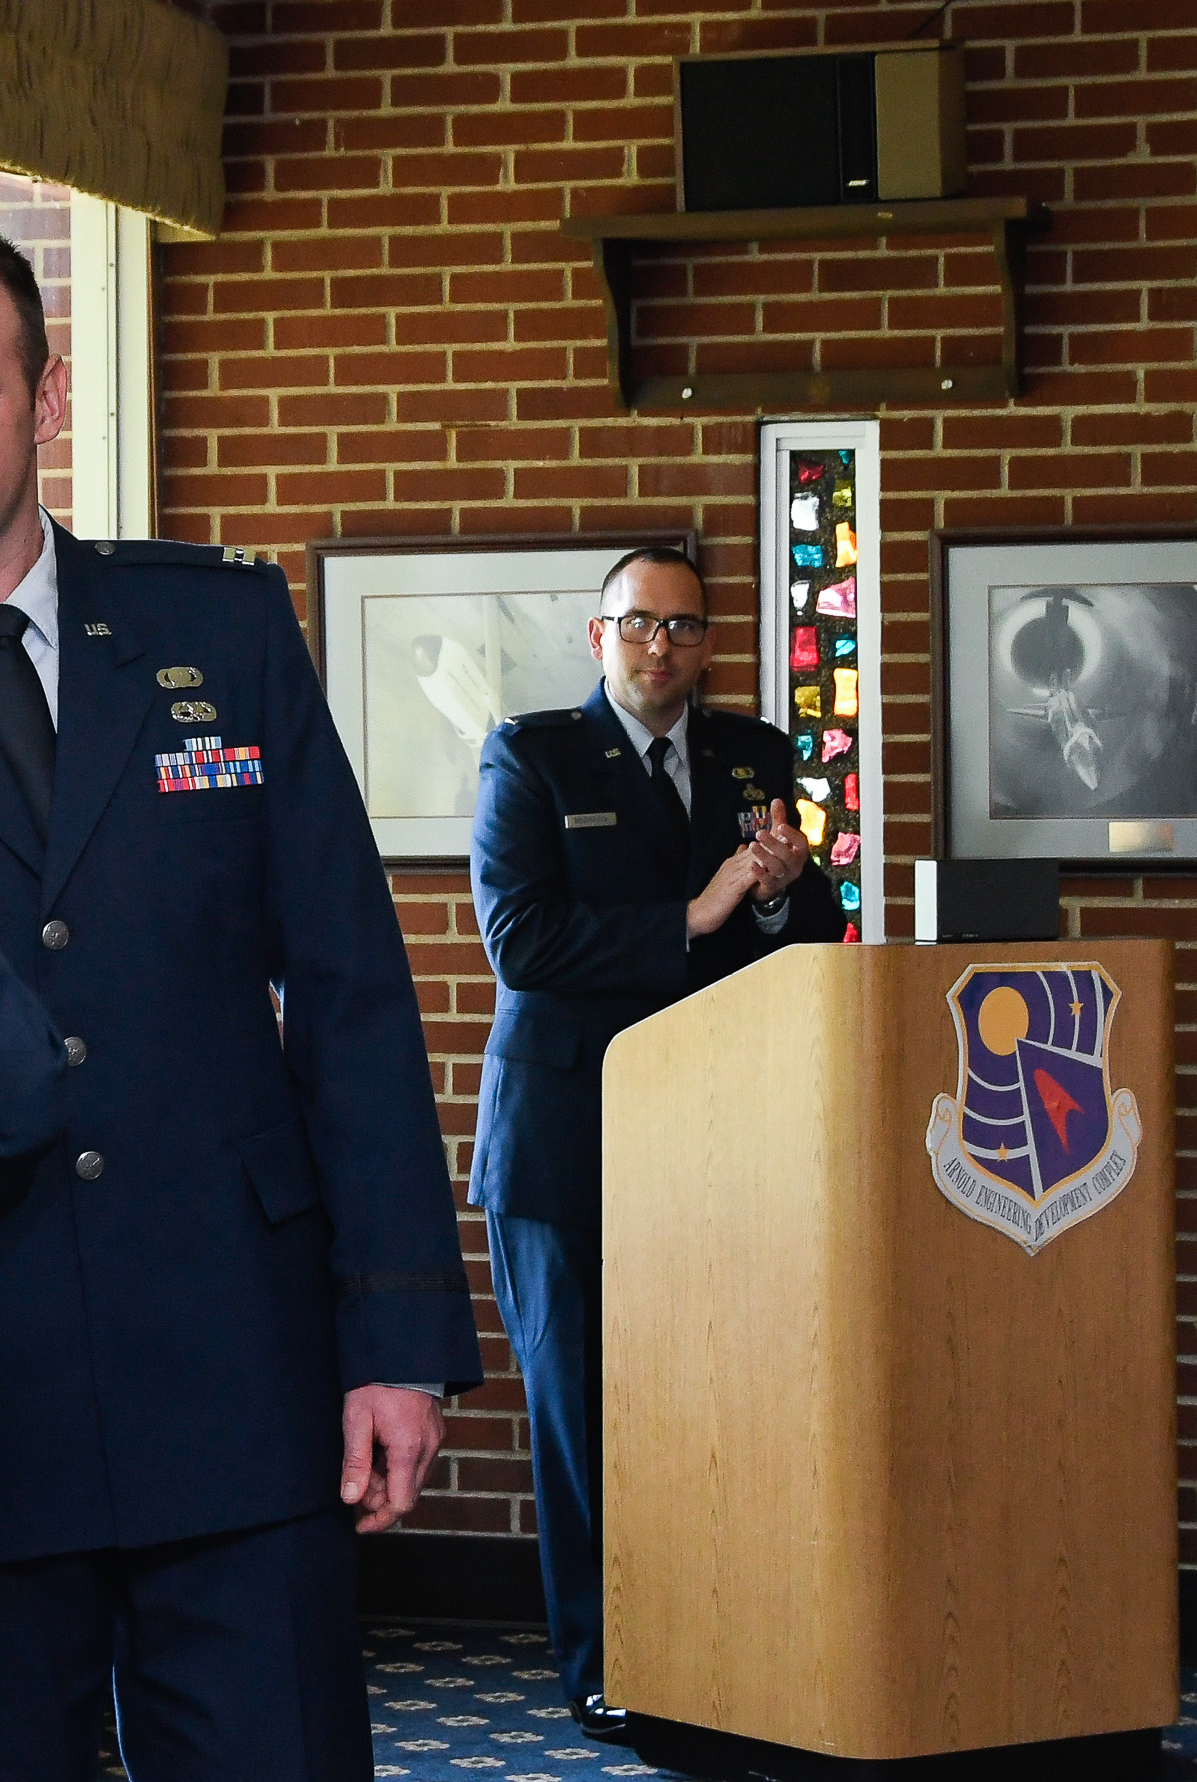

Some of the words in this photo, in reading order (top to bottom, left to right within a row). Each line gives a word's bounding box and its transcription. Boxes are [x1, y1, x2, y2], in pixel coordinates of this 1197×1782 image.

[943, 1157, 977, 1198] ARNOLD
[975, 1184, 1032, 1235] ENGINEERING
[1034, 1182, 1093, 1242] DEVELOPMENT
[1091, 1149, 1127, 1195] COMPLEX
